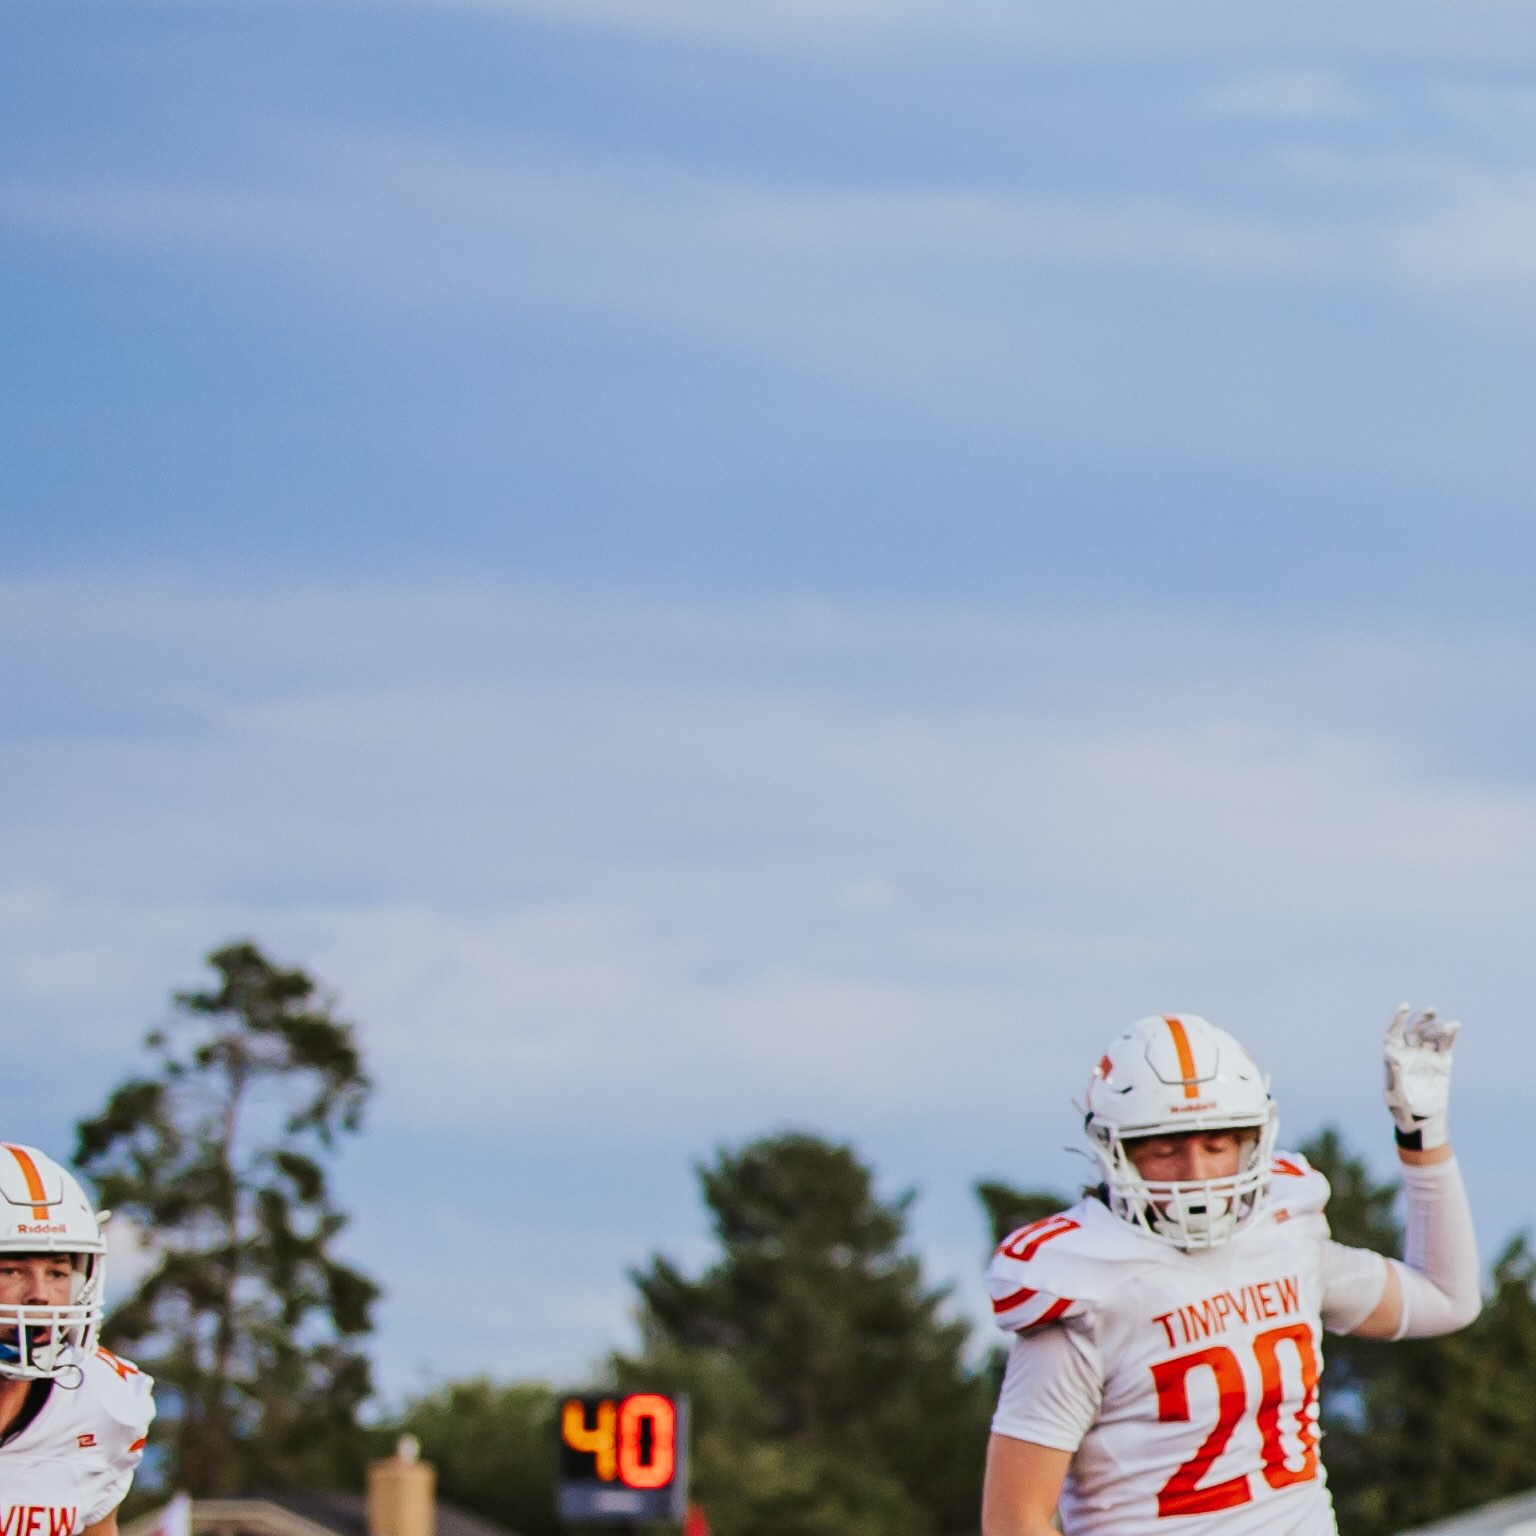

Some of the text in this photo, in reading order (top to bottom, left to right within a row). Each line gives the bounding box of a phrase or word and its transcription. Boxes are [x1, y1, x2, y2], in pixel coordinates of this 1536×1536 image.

[1152, 1275, 1300, 1349] TIMPVIEW
[562, 1393, 675, 1489] 40
[1150, 1322, 1319, 1519] 20
